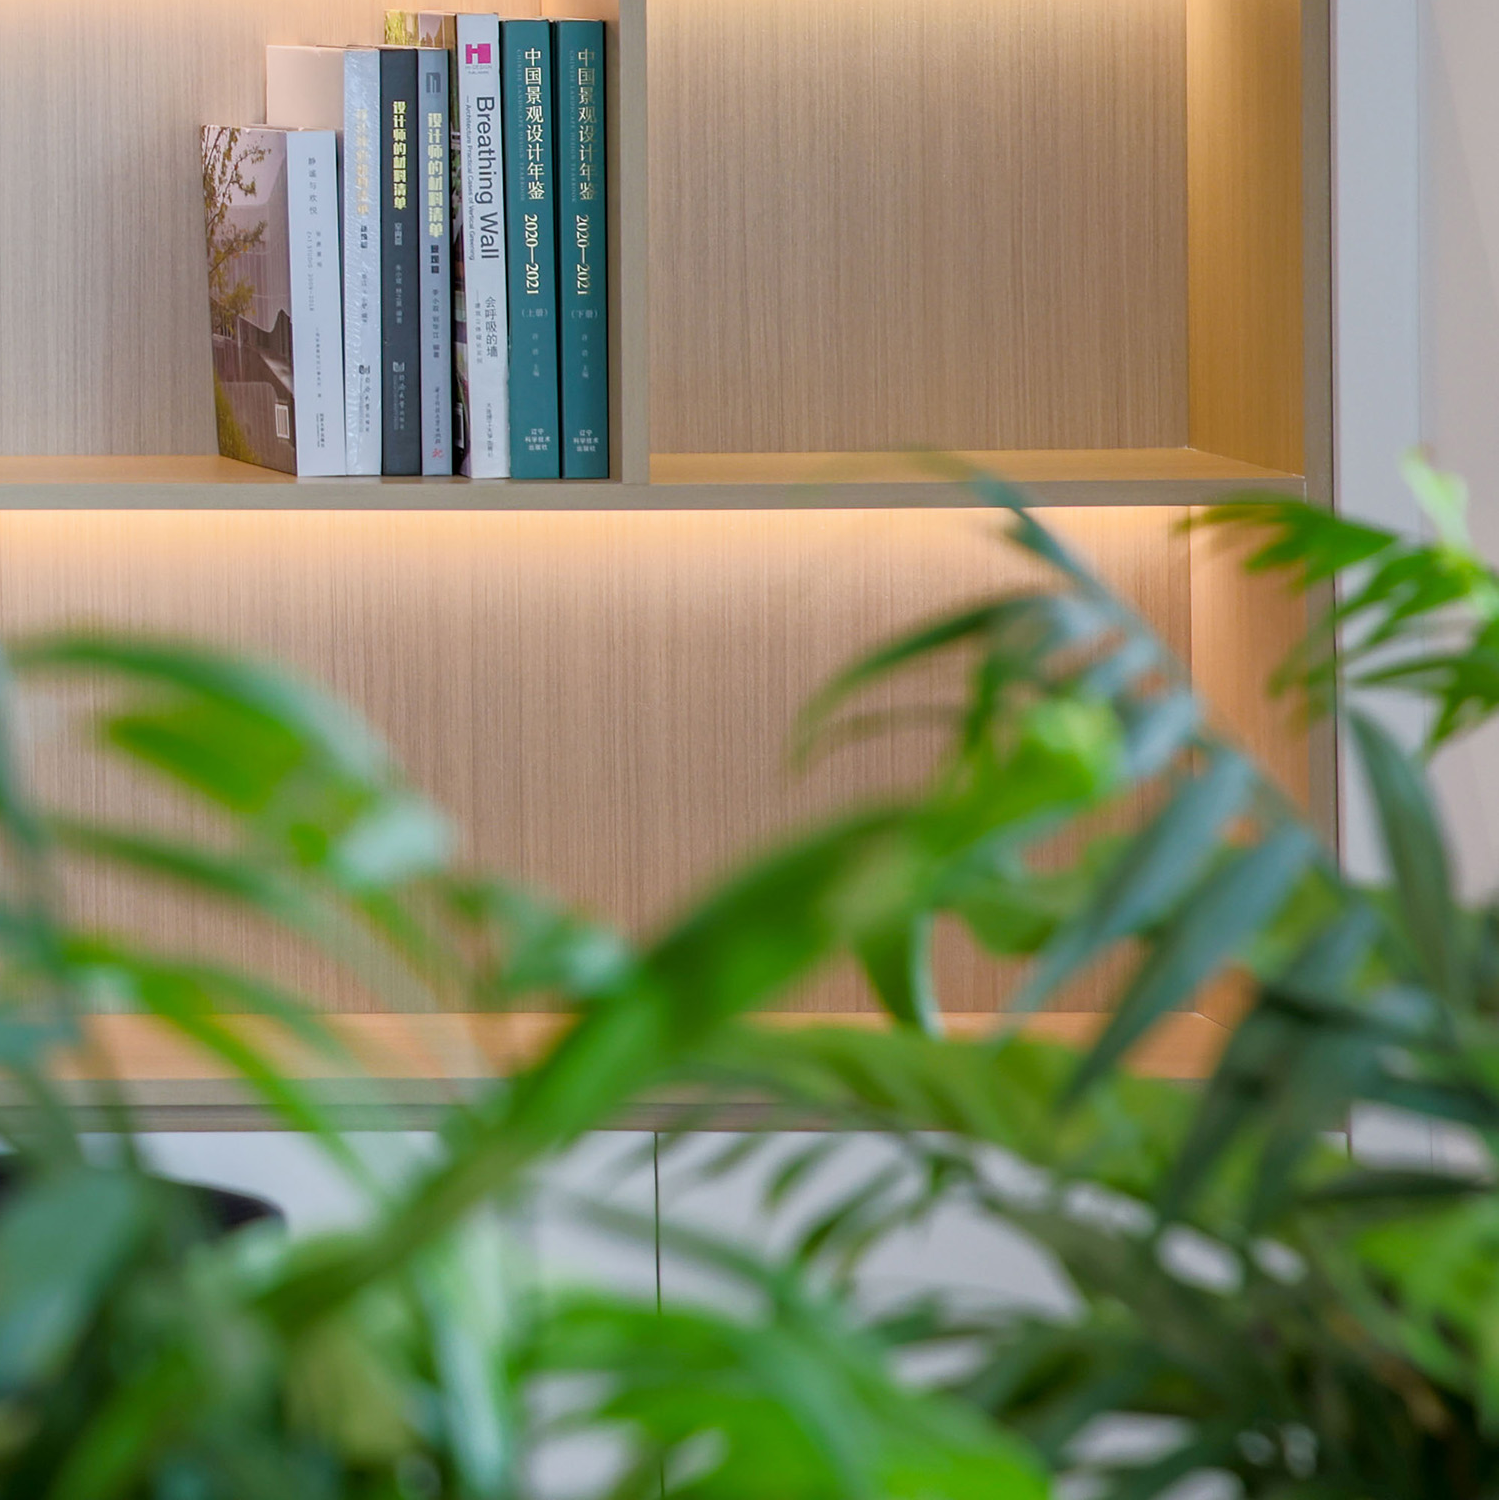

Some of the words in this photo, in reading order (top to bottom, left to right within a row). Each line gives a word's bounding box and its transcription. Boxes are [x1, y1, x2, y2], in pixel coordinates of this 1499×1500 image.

[464, 104, 473, 143] Architecture
[524, 47, 545, 200] 中国景观设计年鉴
[578, 48, 597, 200] 中国景观设计年鉴
[465, 145, 474, 174] Practical
[475, 96, 497, 204] Breathing
[467, 205, 476, 229] Vertical
[481, 212, 499, 259] Wall
[468, 231, 477, 261] Greening
[484, 296, 498, 357] 会呼吸的墙
